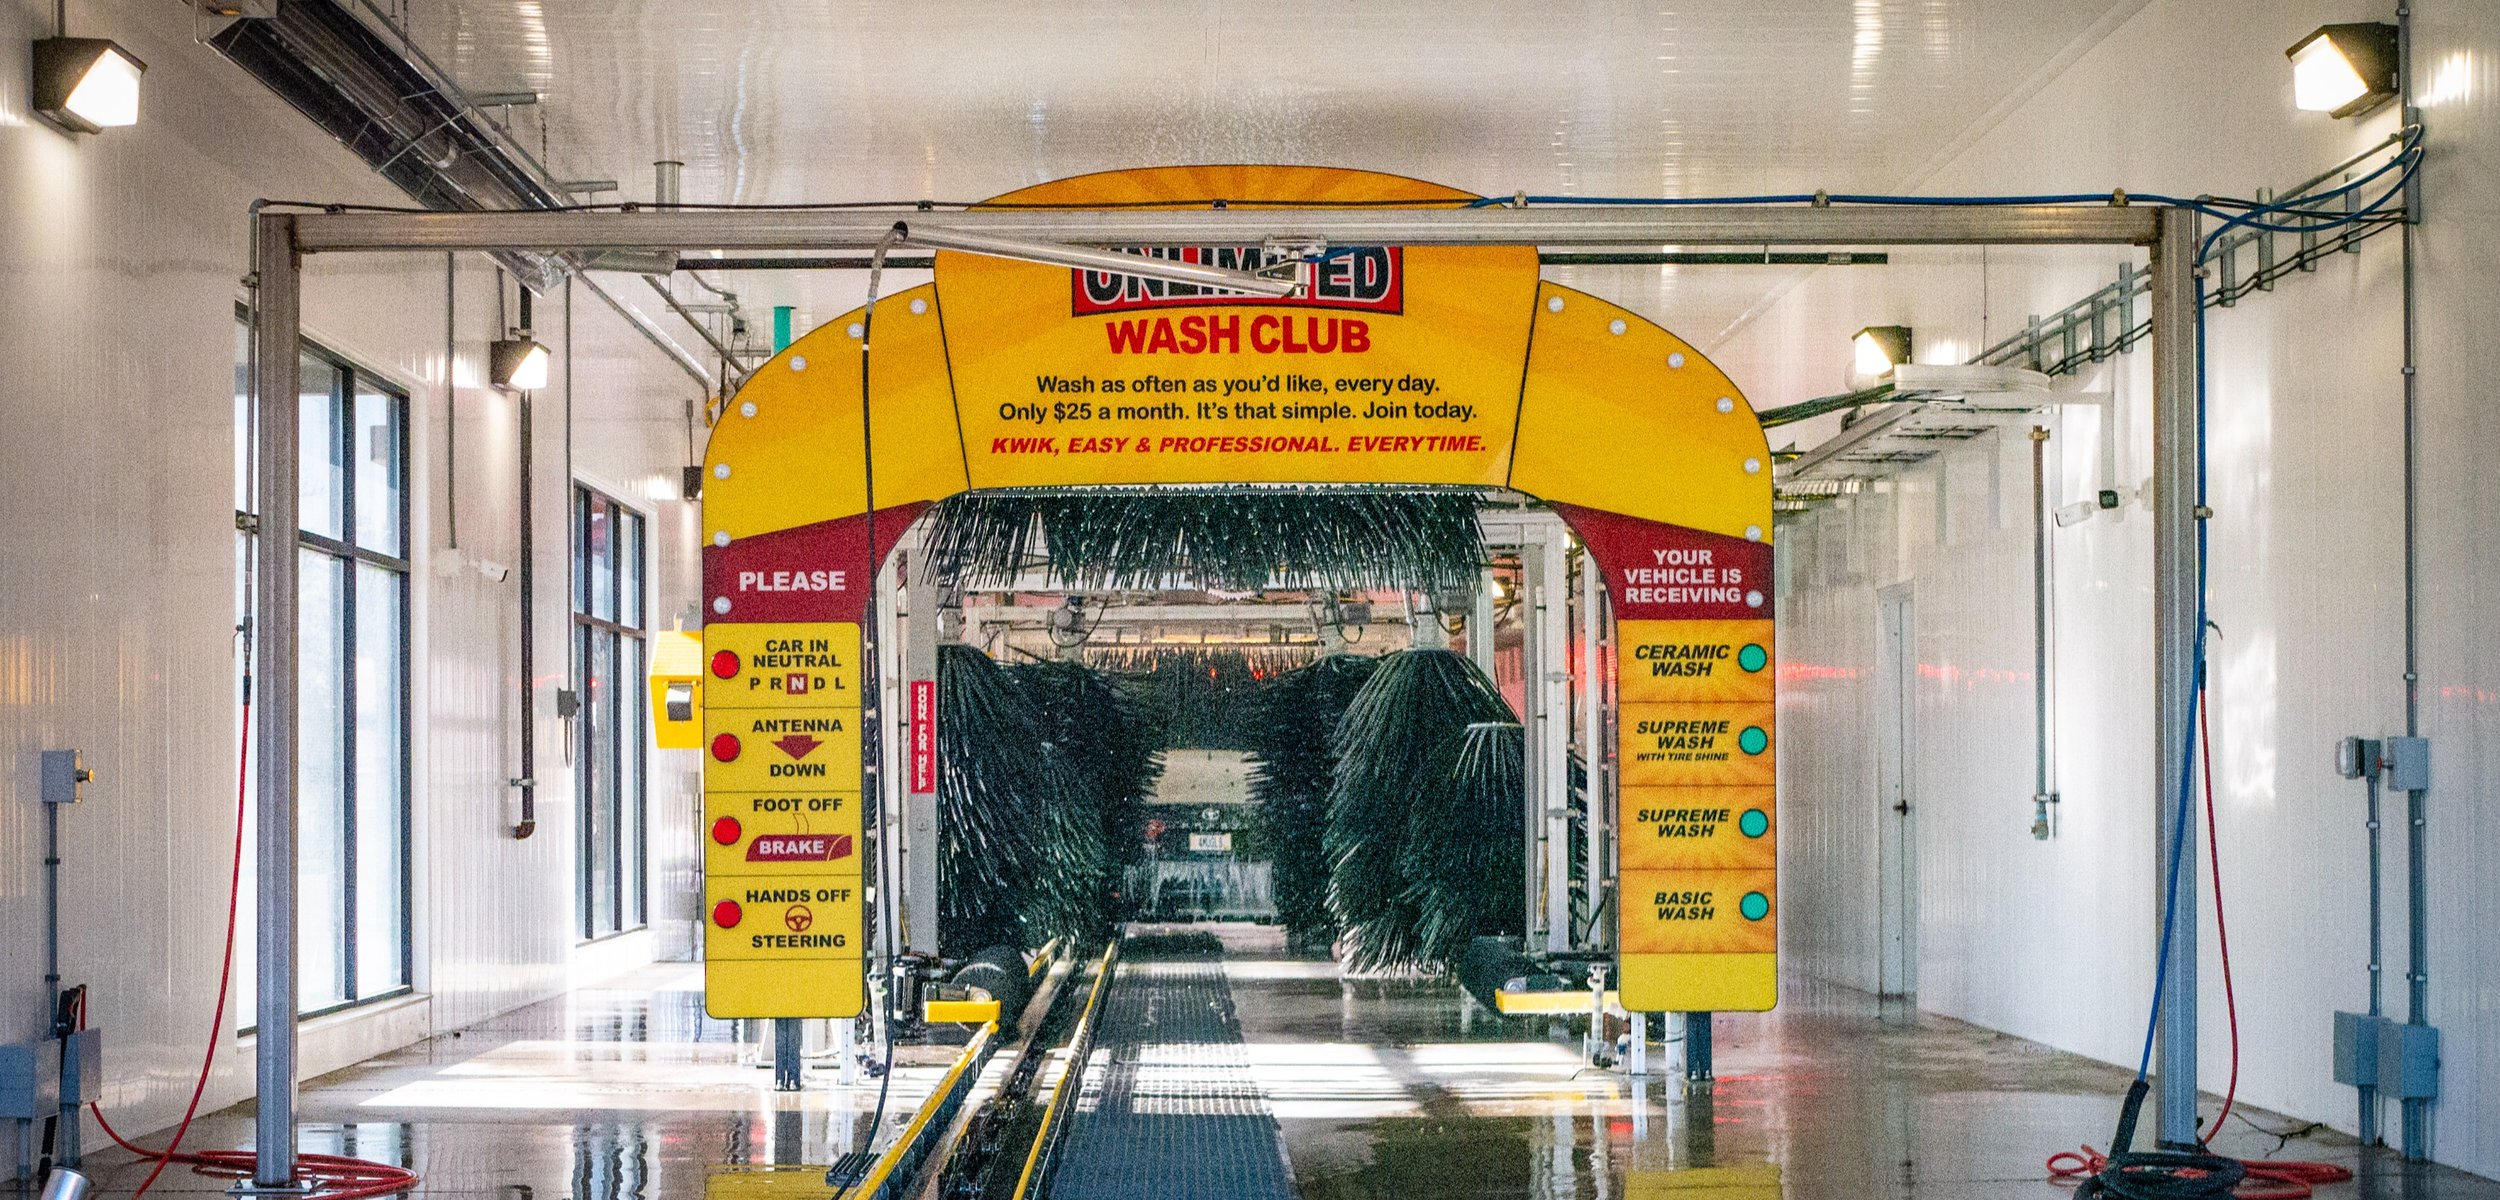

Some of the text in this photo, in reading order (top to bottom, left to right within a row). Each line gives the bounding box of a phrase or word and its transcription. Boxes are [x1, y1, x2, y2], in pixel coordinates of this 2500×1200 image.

[1106, 314, 1371, 355] WASH CLUB
[1036, 373, 1440, 397] Wash as often as you'd like, every day.
[998, 400, 1477, 425] Only $25 a month. It's that simple. Join today.
[991, 437, 1060, 456] KWIK,
[1067, 437, 1130, 454] EASY
[1135, 436, 1151, 453] &
[1159, 436, 1340, 453] PROFESSIONAL.
[1653, 549, 1713, 566] YOUR
[739, 570, 846, 592] PLEASE
[1624, 568, 1742, 585] VEHICLE IS
[1625, 587, 1742, 603] RECEIVING
[765, 639, 829, 653] CAR IN
[1634, 644, 1731, 660] CERAMIC
[753, 654, 842, 668] NEUTRAL
[1652, 661, 1713, 677] WASH
[917, 684, 928, 721] HONK
[752, 719, 843, 733] ANTENNA
[1636, 720, 1730, 735] SUPREME
[918, 723, 928, 751] FOR
[1657, 735, 1715, 750] WASH
[1636, 752, 1729, 762] WITH TIRE SHINE
[769, 763, 826, 778] DOWN
[752, 798, 843, 813] FOOT OFF
[1637, 808, 1730, 823] SUPREME
[1658, 824, 1715, 838] WASH
[759, 839, 825, 855] BRAKE
[745, 888, 851, 903] HANDS OFF
[1654, 891, 1713, 906] BASIC
[1658, 906, 1715, 921] WASH
[751, 934, 846, 949] STEERING
